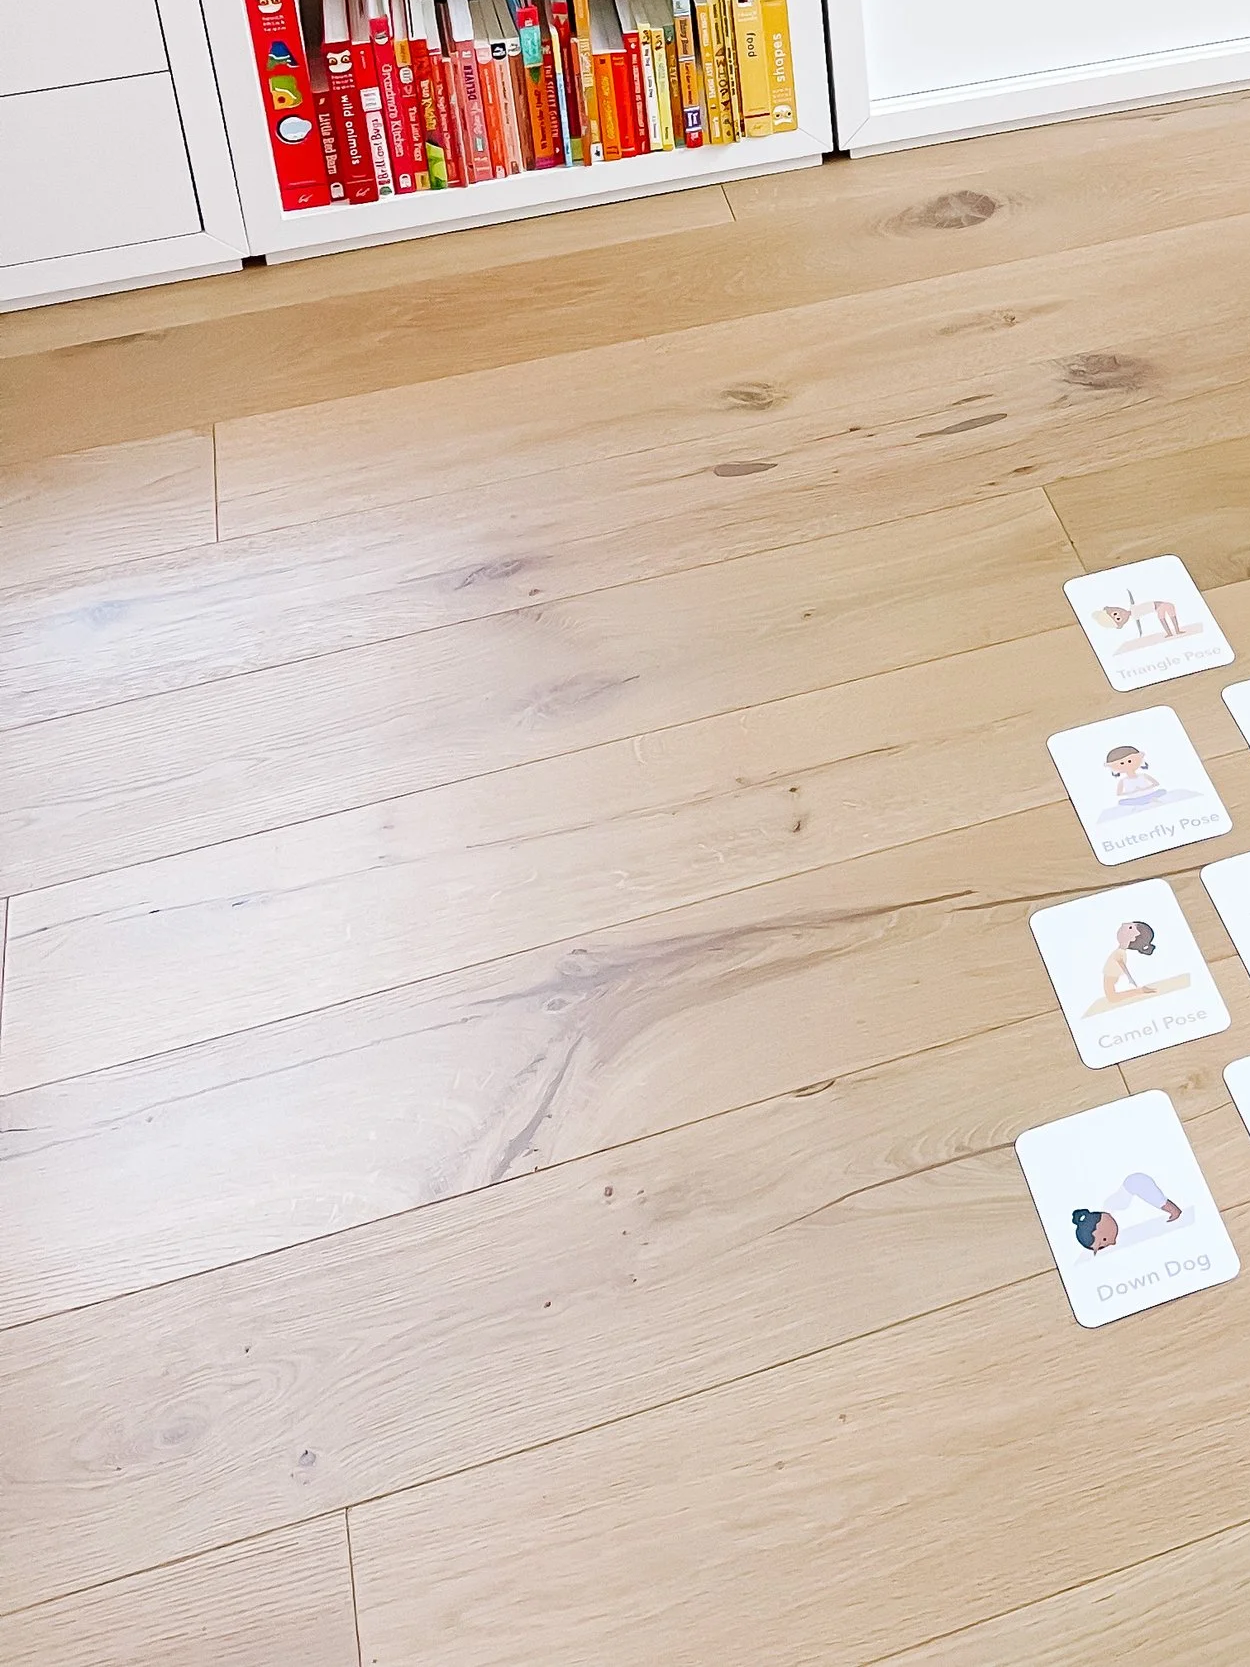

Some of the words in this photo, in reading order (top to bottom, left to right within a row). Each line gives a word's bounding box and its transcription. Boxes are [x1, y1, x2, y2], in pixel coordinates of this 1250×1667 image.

[745, 32, 758, 58] food
[772, 33, 786, 82] shapes
[543, 65, 553, 78] THE
[669, 65, 680, 83] EYE
[340, 95, 355, 117] wild
[546, 81, 557, 108] SECRET
[318, 113, 334, 137] Little
[549, 110, 560, 138] GARDEN
[322, 137, 336, 154] Red
[345, 121, 362, 165] animals
[325, 154, 338, 175] Barn
[1115, 655, 1181, 679] Triangle
[1184, 646, 1222, 662] Pose
[1101, 823, 1176, 853] Butterfly
[1179, 813, 1220, 830] Pose
[1097, 1019, 1159, 1049] Camel
[1162, 1008, 1208, 1030] Pose
[1096, 1271, 1161, 1302] Down
[1164, 1253, 1212, 1277] Dog
